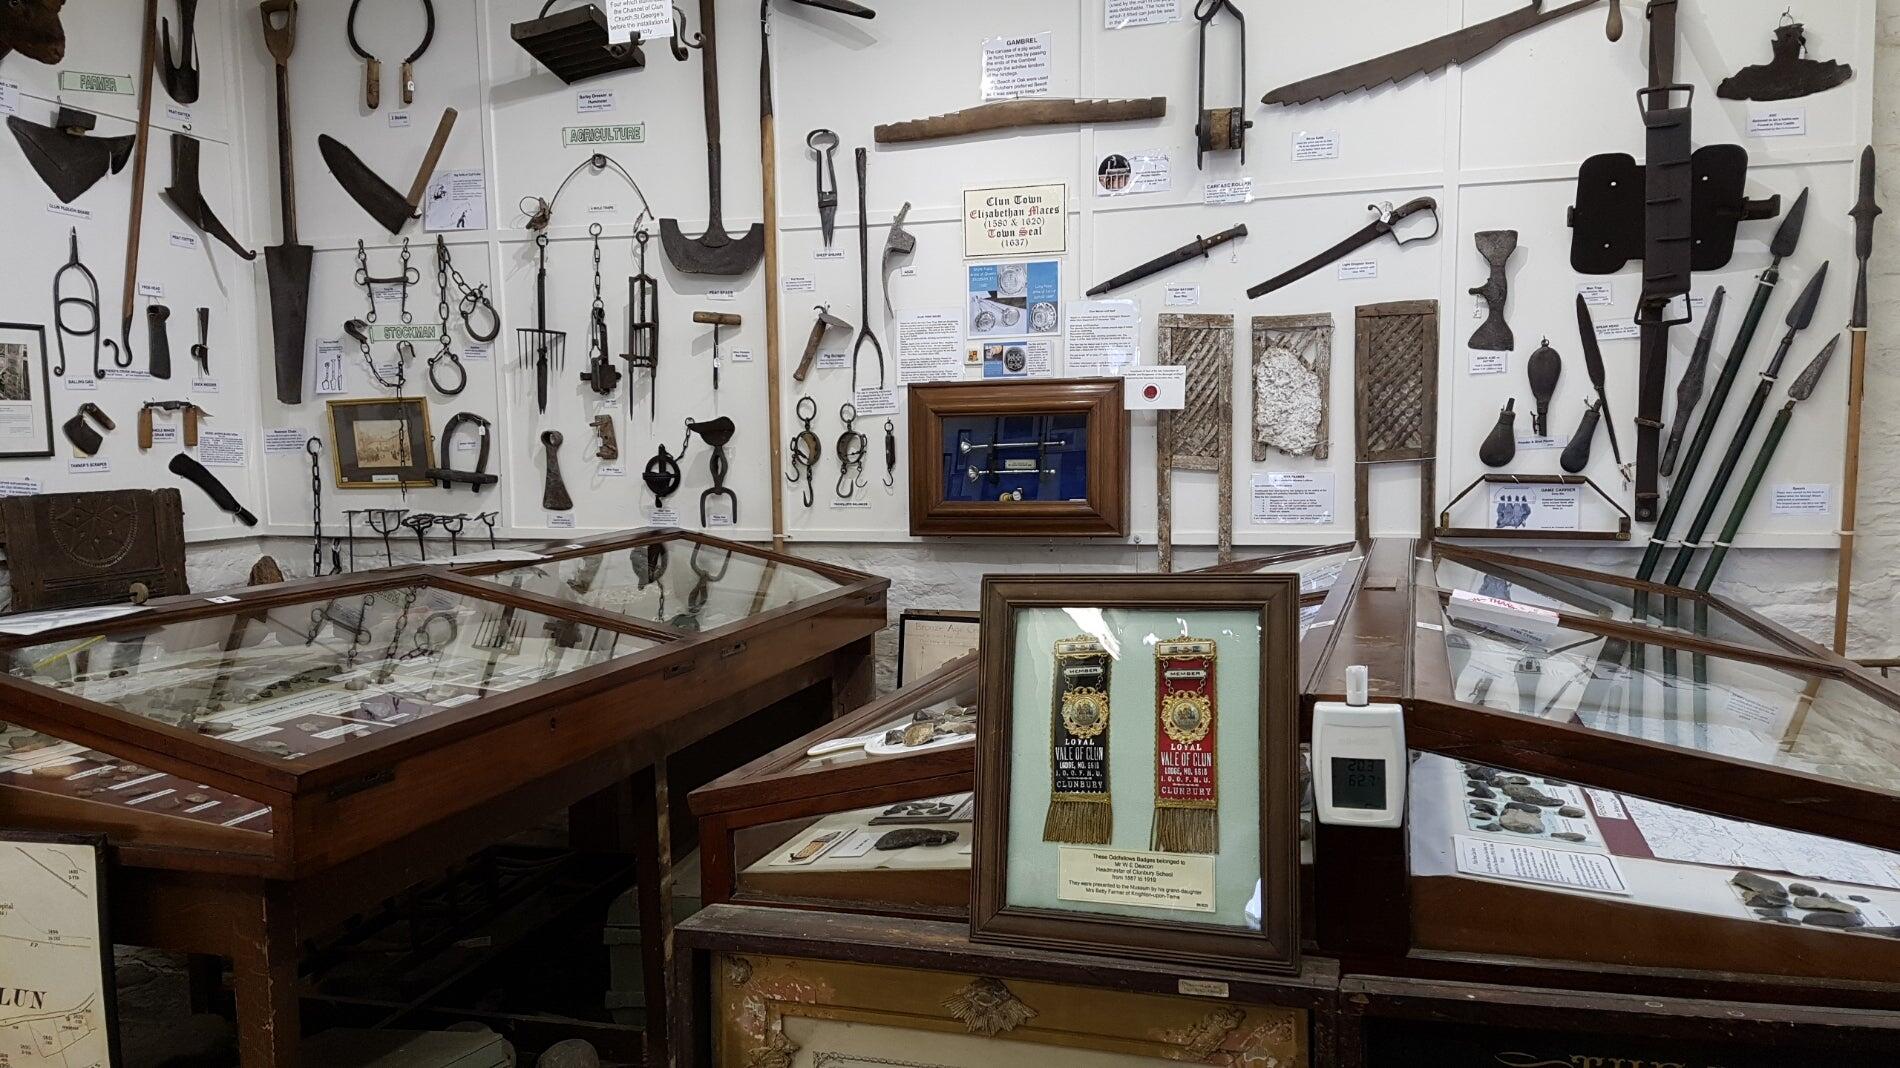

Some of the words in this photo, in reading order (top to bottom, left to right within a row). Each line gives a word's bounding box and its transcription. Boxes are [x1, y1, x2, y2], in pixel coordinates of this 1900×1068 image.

[636, 19, 664, 27] installation
[1006, 37, 1038, 46] GAMBREL
[80, 74, 117, 92] FARMER
[570, 126, 641, 143] AGRICULTURE
[986, 196, 1010, 207] Clun
[1014, 195, 1042, 205] Town
[969, 207, 1025, 220] Elizabethan
[1028, 205, 1060, 217] Maces
[1010, 219, 1018, 227] &
[1021, 217, 1046, 226] 1620)
[987, 228, 1016, 239] Town
[1018, 227, 1042, 237] Seal
[1001, 239, 1029, 248] (1637)
[383, 326, 436, 340] STOCKMAN
[1065, 738, 1095, 746] LOYAL
[1170, 743, 1202, 751] LOYAL
[1055, 746, 1074, 761] VALE
[1075, 746, 1084, 761] OF
[1086, 746, 1104, 761] CLUN
[1160, 751, 1180, 766] VALE
[1181, 752, 1191, 767] OF
[1192, 752, 1212, 767] CLUN
[1183, 767, 1193, 776] NO.
[1056, 780, 1103, 789] CLUNBURY
[1161, 786, 1212, 796] CLUNBURY
[1108, 854, 1136, 862] Oddfellows
[1136, 856, 1156, 864] Badges
[1156, 858, 1180, 866] belonged
[1095, 866, 1126, 874] Headmaster
[1132, 869, 1155, 877] Clunbury
[1165, 887, 1202, 895] grand-daughter
